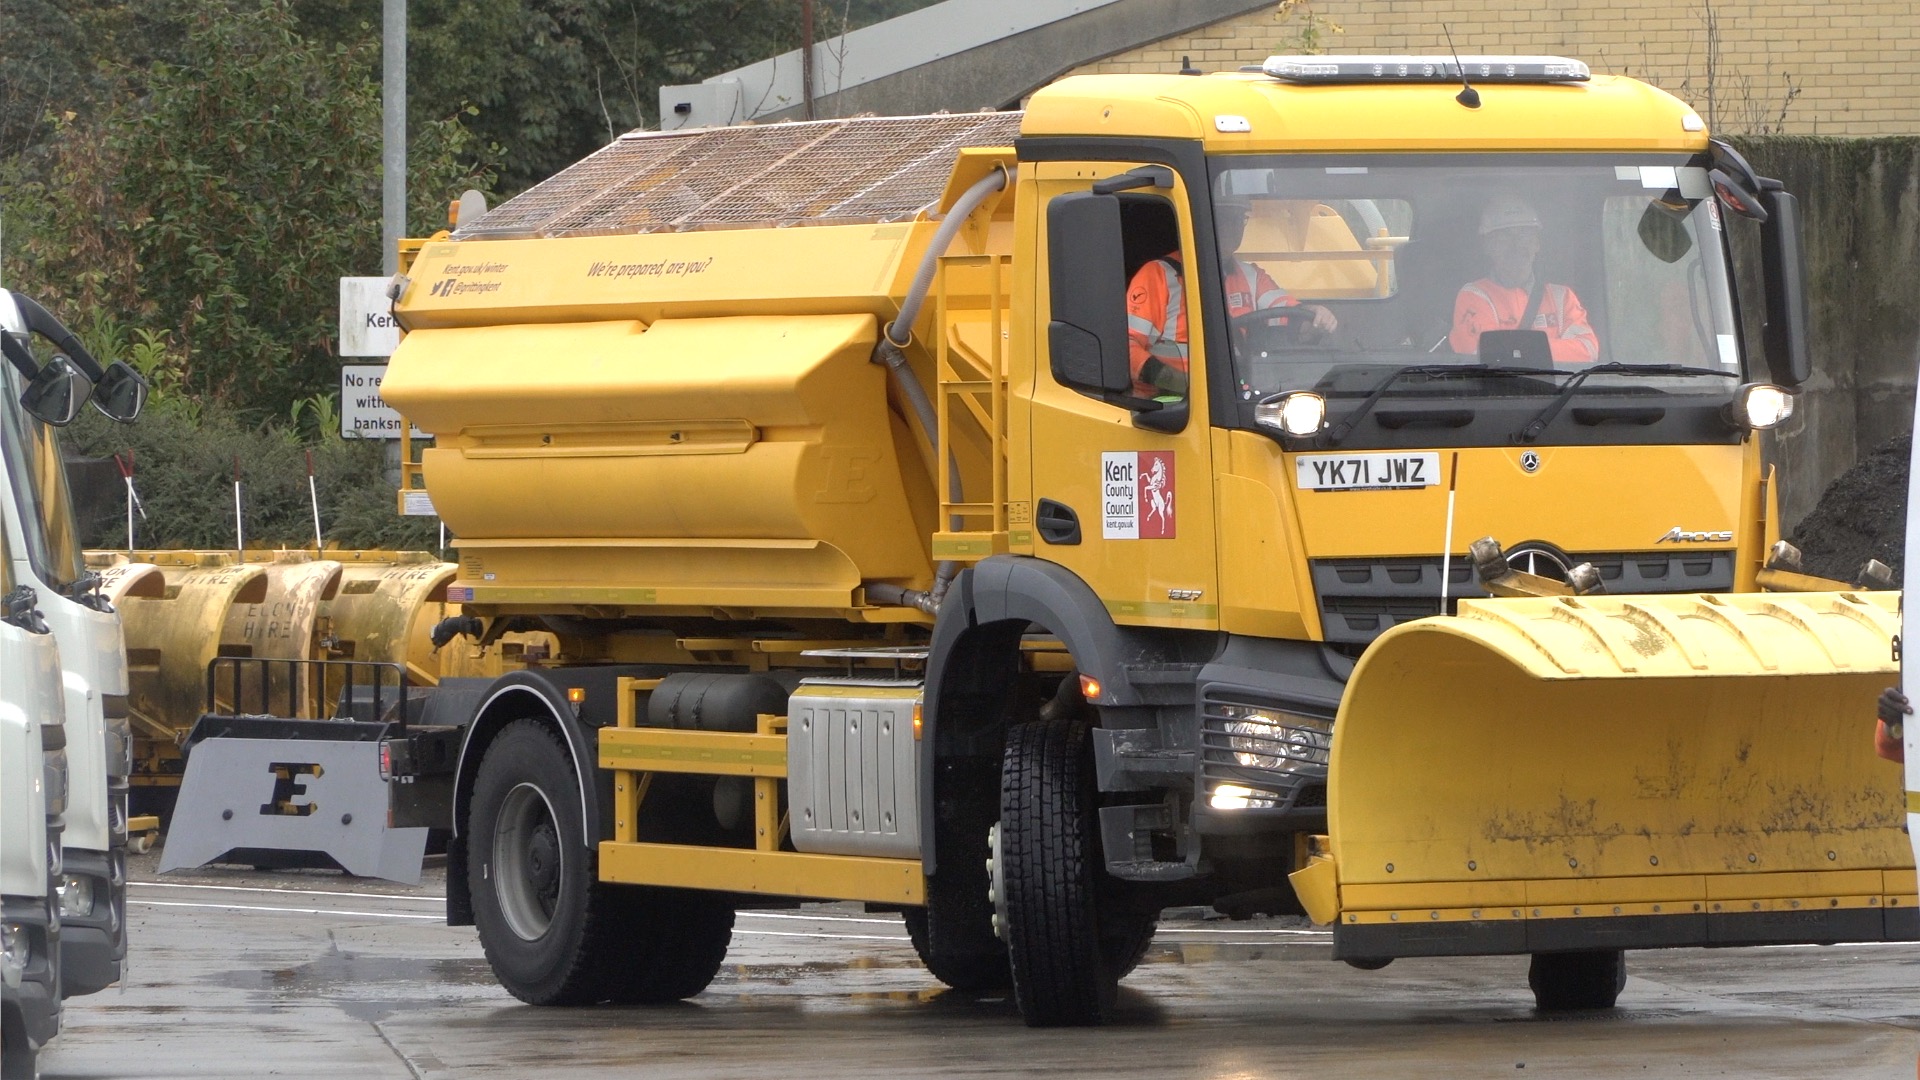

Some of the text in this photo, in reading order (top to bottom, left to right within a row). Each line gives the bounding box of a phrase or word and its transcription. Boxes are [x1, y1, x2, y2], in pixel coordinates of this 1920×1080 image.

[587, 257, 713, 280] We're prepared, are you?
[345, 374, 364, 387] No
[356, 395, 391, 408] with
[1105, 461, 1133, 481] Kent
[1312, 458, 1425, 485] YK71 JWZ
[1105, 484, 1134, 500] County
[1106, 501, 1134, 515] Council
[1106, 520, 1134, 530] kent.gov.uk
[260, 762, 325, 816] E
